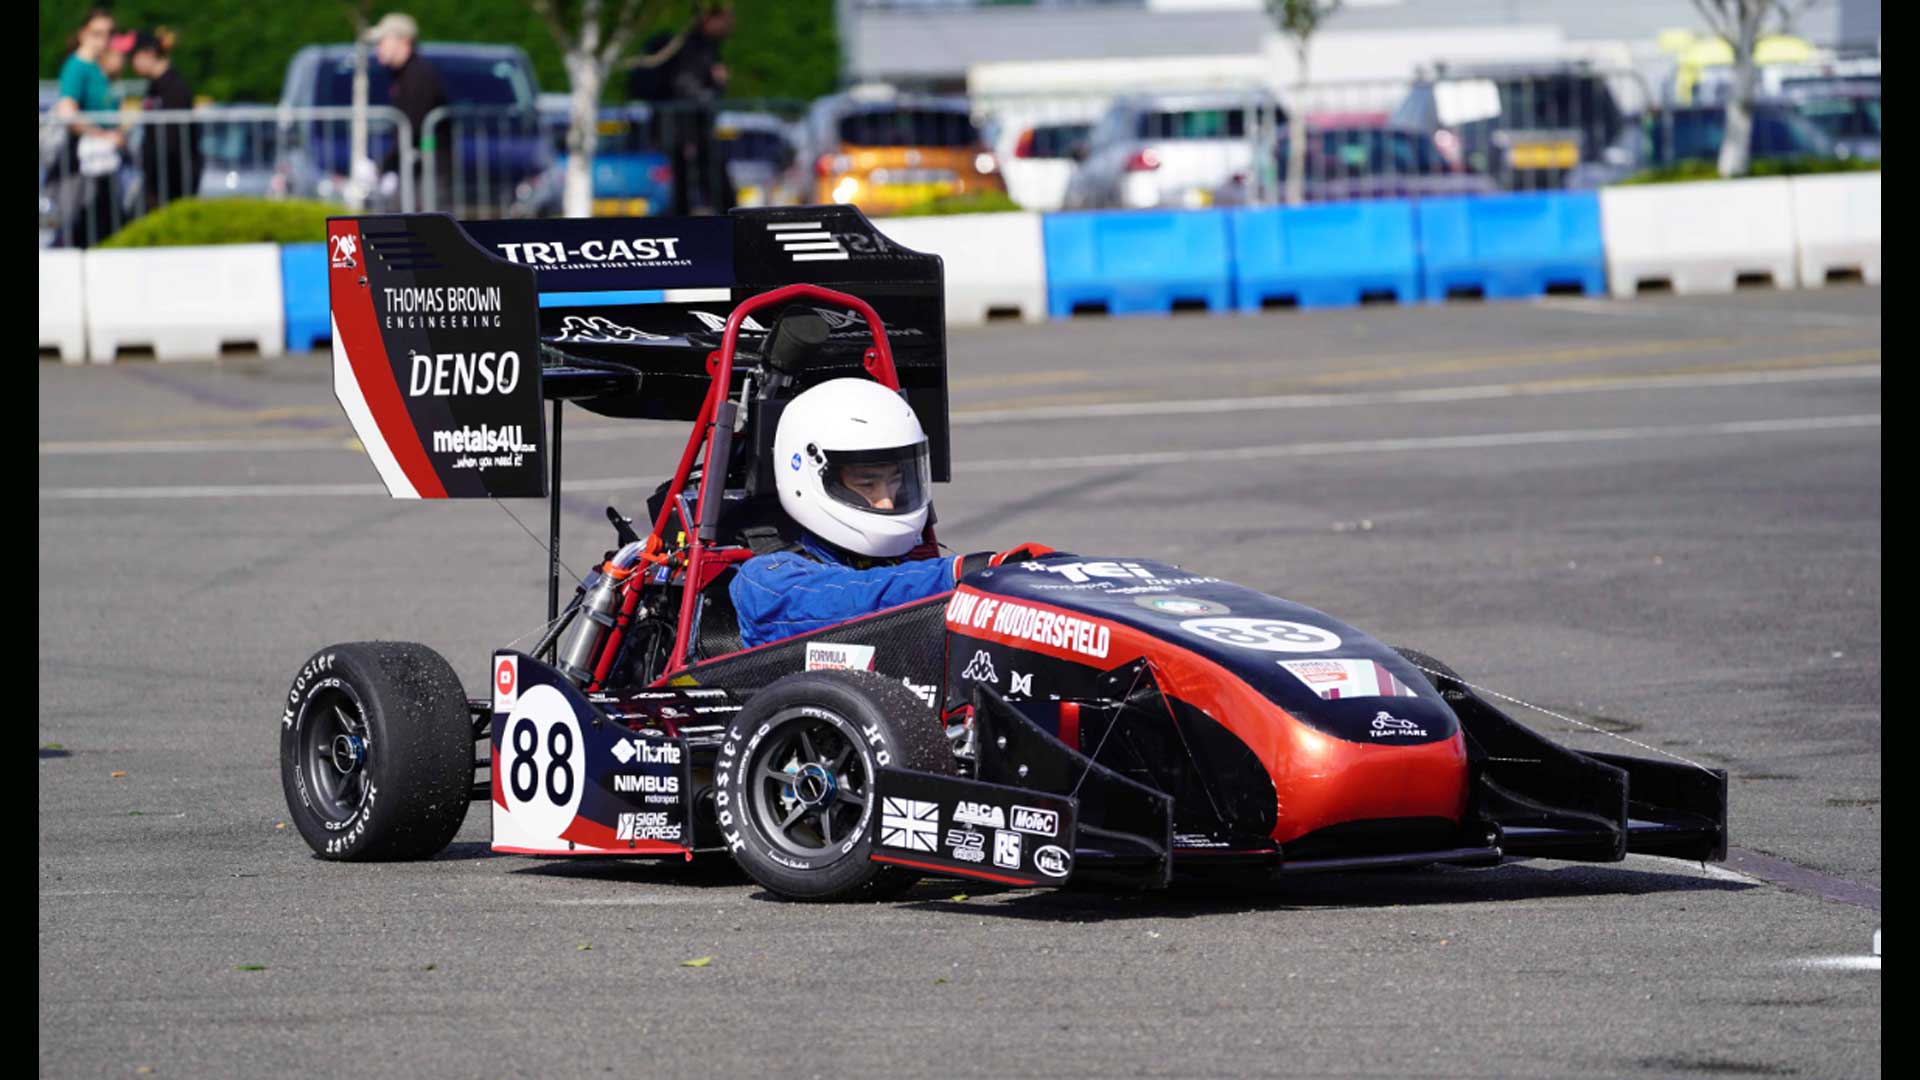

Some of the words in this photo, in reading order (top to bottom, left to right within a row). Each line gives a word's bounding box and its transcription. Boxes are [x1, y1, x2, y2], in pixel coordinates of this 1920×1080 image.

[497, 237, 680, 264] TRI-CAST
[384, 287, 444, 312] THOMAS
[447, 286, 501, 311] BROWN
[386, 315, 501, 328] ENGINEERING
[409, 351, 520, 396] DENSO
[946, 591, 978, 626] UNI
[973, 598, 999, 629] OF
[993, 602, 1110, 659] HUDDERSFIELD
[1195, 625, 1326, 644] 88
[809, 649, 847, 664] FORMULA
[283, 653, 336, 729] Hoosier
[1369, 729, 1396, 738] TEAM
[1399, 729, 1428, 737] HARE
[510, 717, 574, 807] 88
[633, 739, 681, 765] Thorite
[614, 774, 679, 793] NIMBUS
[715, 725, 746, 855] Hoosier
[326, 784, 378, 853] Hoosier
[633, 822, 682, 840] EXPRESS
[634, 812, 669, 826] SIGNS
[1015, 809, 1054, 833] MoTeC
[996, 832, 1020, 867] RS
